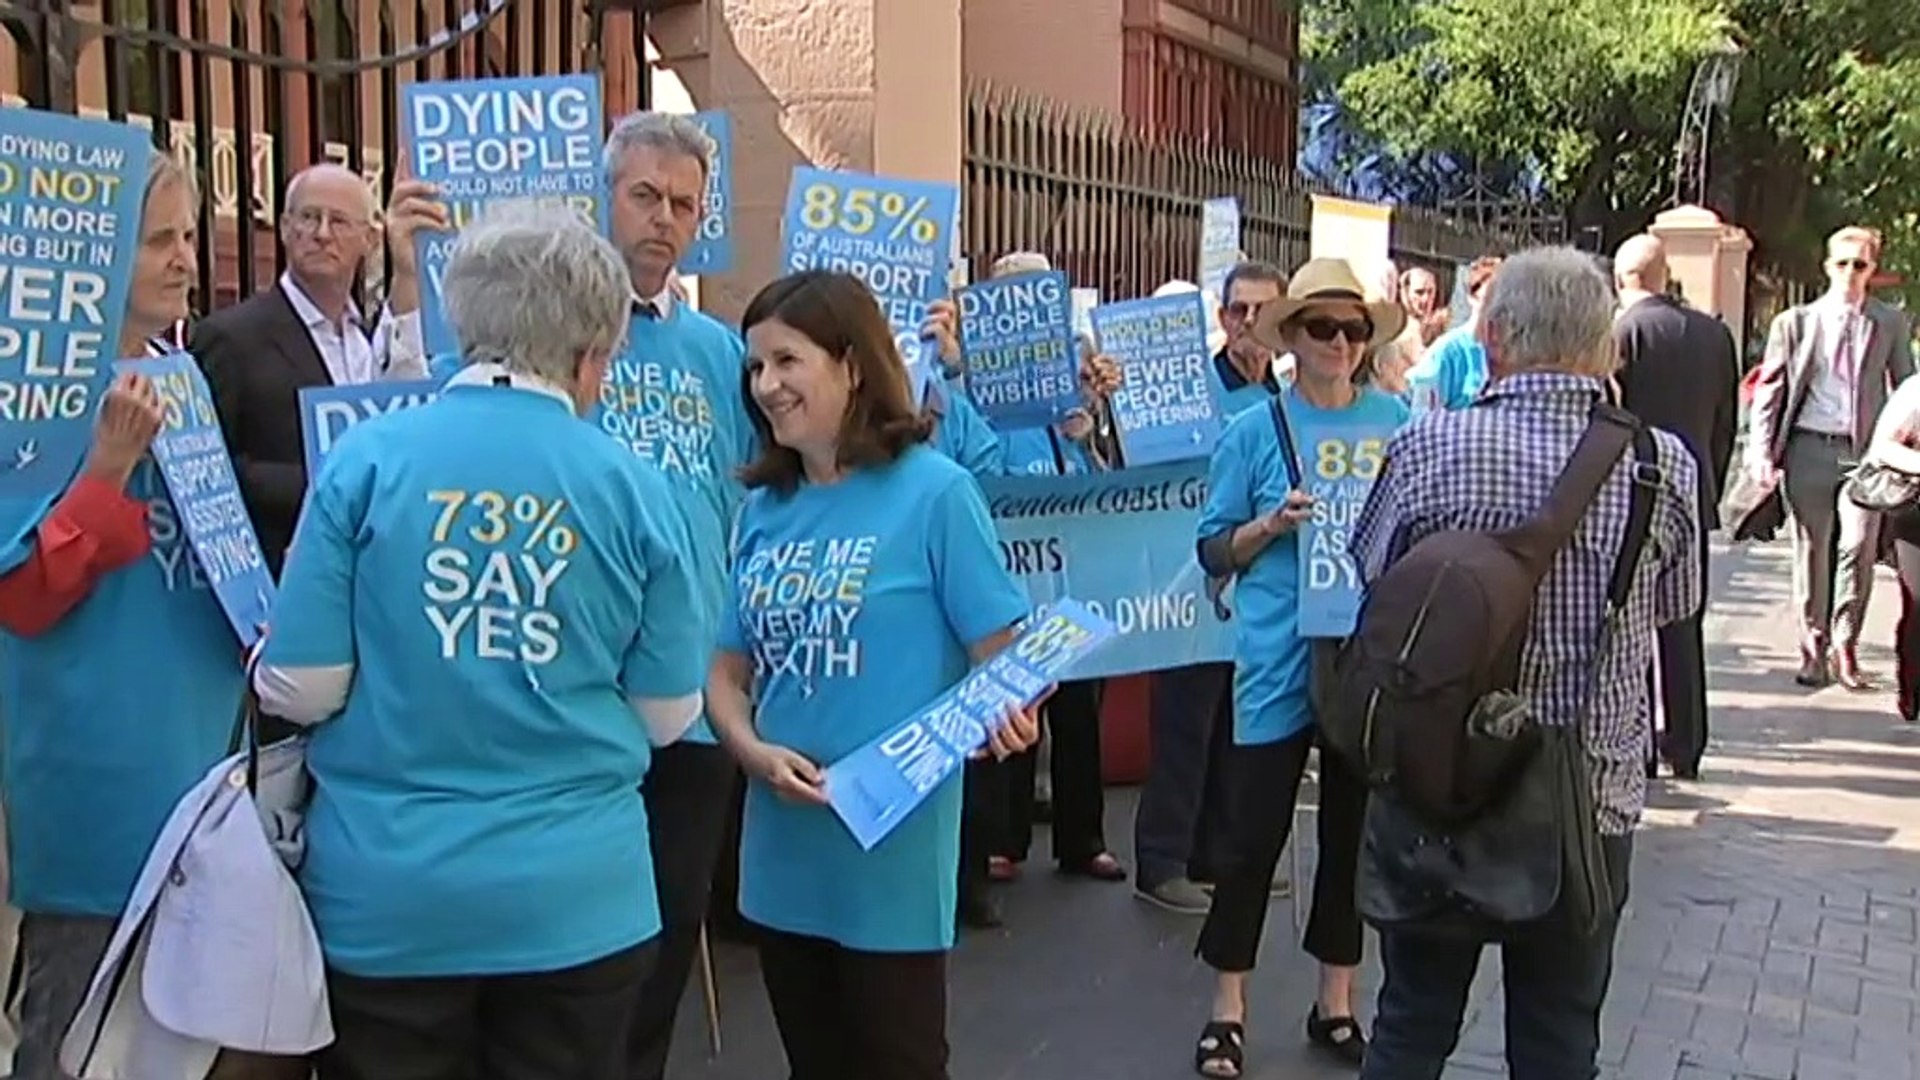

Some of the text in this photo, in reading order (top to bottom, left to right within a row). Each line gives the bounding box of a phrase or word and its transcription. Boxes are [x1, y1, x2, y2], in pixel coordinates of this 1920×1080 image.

[412, 87, 590, 138] DYING
[2, 134, 125, 170] DYING LAW
[418, 134, 593, 177] PEOPLE
[30, 166, 120, 207] NOT
[573, 172, 595, 191] TO
[23, 204, 118, 238] MORE
[801, 184, 938, 244] 85%
[34, 237, 85, 264] BUT
[90, 241, 114, 267] IN
[793, 230, 935, 266] OF AUSTRALIANS
[0, 266, 106, 325] ER
[960, 277, 1061, 316] DYING
[962, 304, 1065, 340] PEOPLE
[1123, 353, 1205, 388] EWER
[600, 382, 712, 427] CHOICE
[972, 374, 1074, 406] WISHES
[1113, 380, 1209, 411] PEOPLE
[1097, 480, 1171, 514] Coast
[425, 489, 578, 555] 73%
[824, 535, 877, 567] ME
[423, 548, 569, 608] SAY
[1116, 591, 1197, 634] DYING
[424, 605, 561, 664] YES
